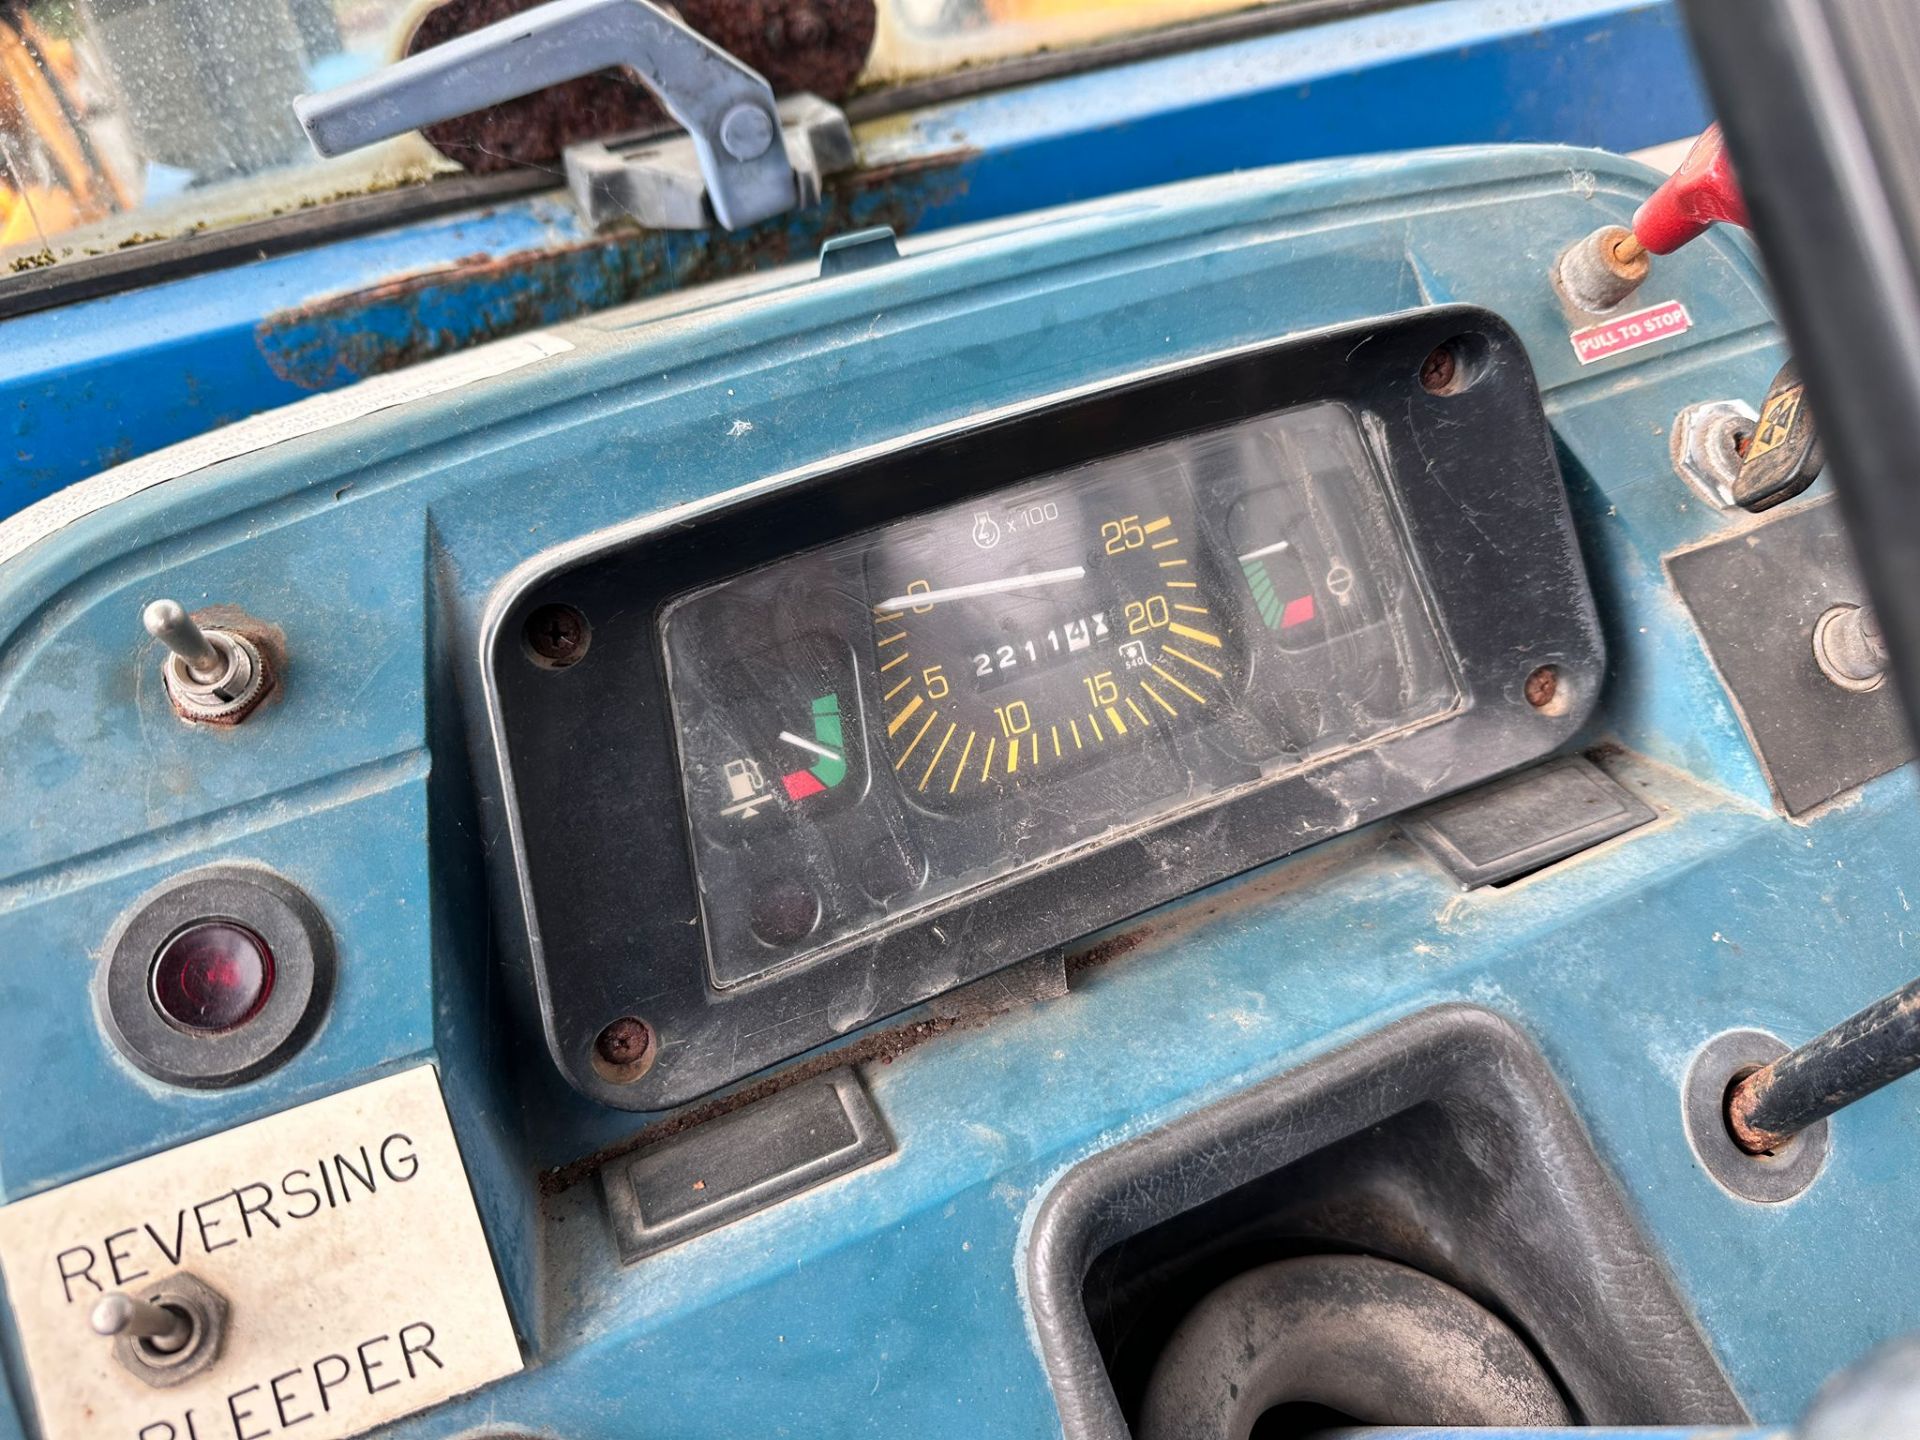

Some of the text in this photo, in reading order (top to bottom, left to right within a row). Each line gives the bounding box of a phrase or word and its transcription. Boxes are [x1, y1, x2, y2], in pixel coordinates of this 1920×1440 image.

[1579, 310, 1681, 352] PULL TO STOP
[1022, 503, 1058, 527] 100
[1101, 515, 1145, 555] 25
[907, 580, 934, 614] 0
[1125, 595, 1169, 635] 20
[1125, 657, 1144, 670] 540
[922, 665, 949, 699] 5
[1083, 671, 1118, 707] 15
[994, 700, 1031, 737] 10
[56, 1132, 419, 1303] REVERSING
